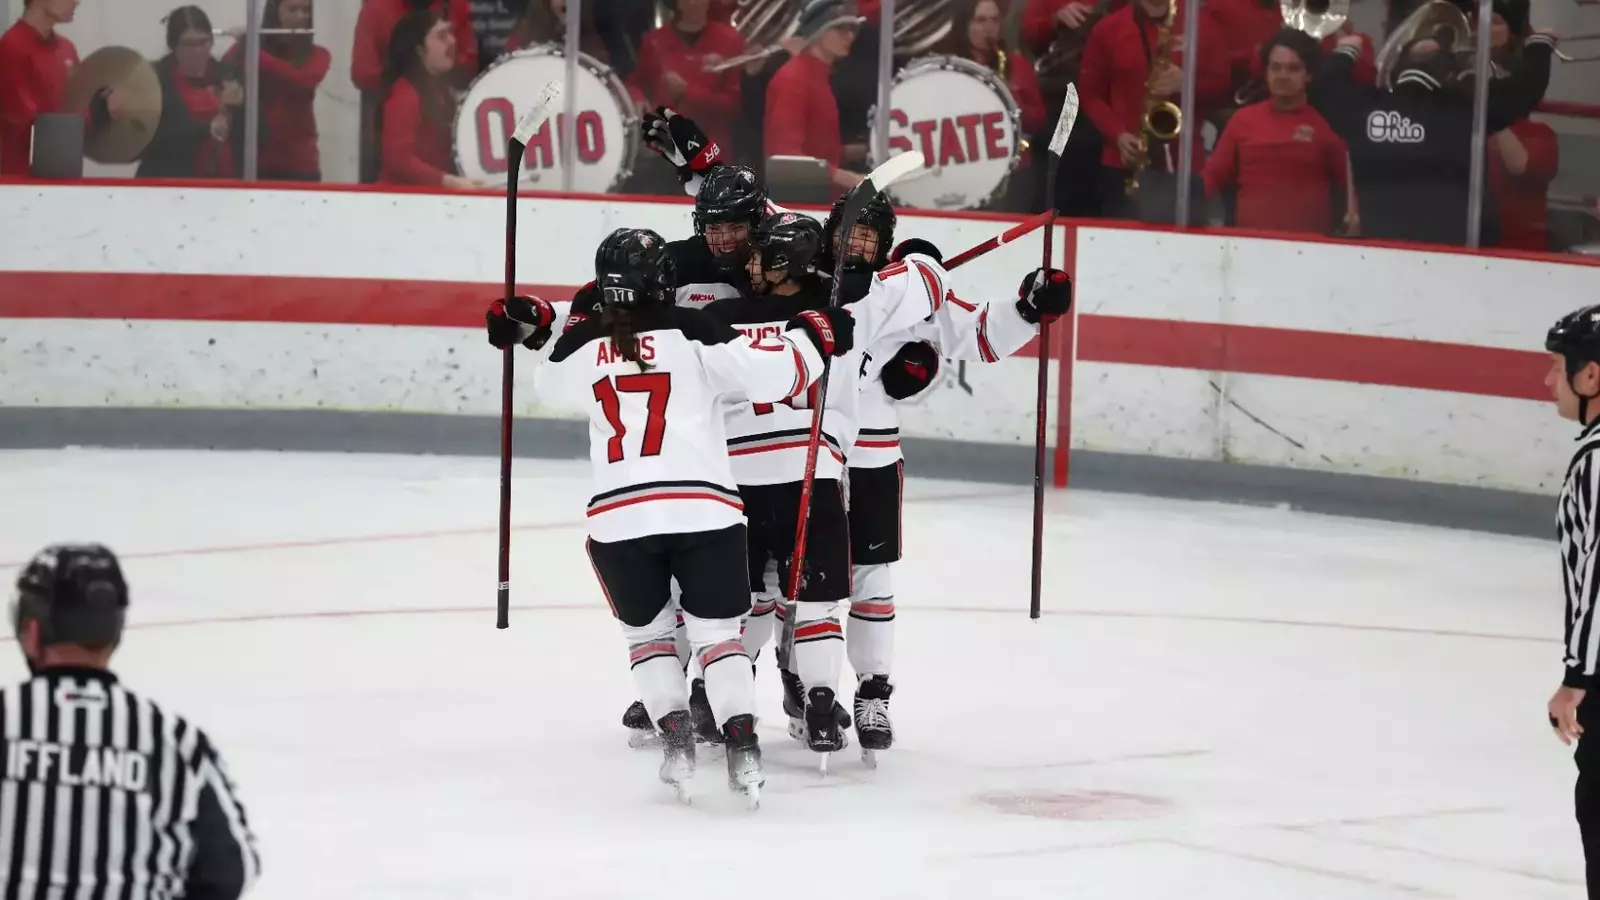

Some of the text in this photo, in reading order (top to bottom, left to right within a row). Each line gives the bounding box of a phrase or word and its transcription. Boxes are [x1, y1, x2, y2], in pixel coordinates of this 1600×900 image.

[475, 97, 606, 174] OHIO
[1367, 110, 1425, 142] Ohio
[592, 372, 672, 464] 17
[6, 741, 149, 792] IFFLAND
